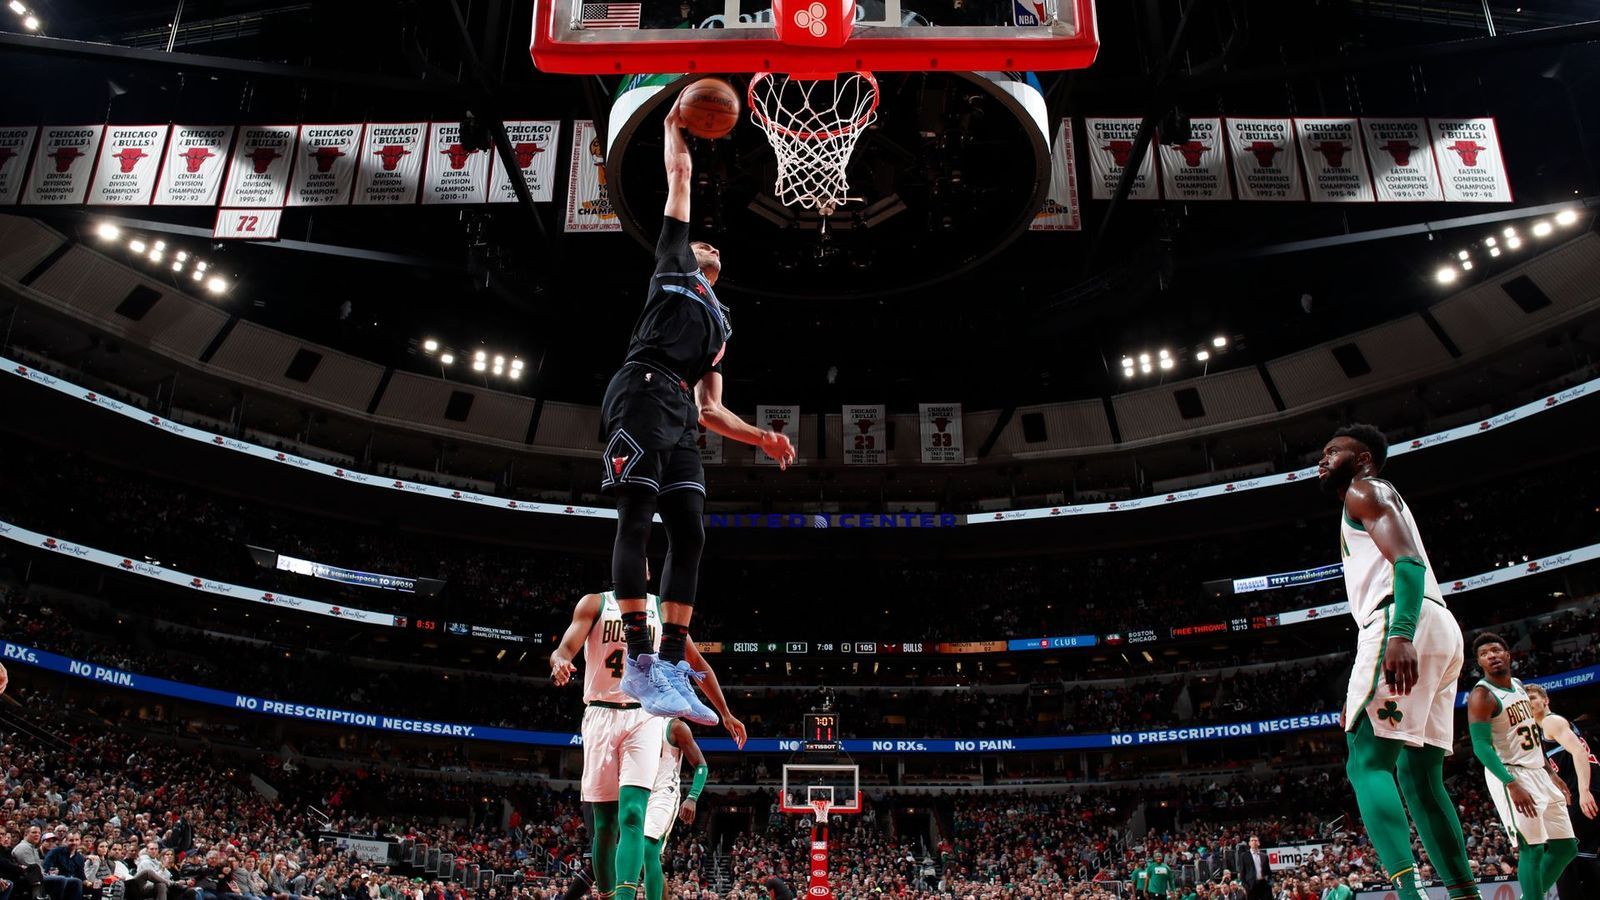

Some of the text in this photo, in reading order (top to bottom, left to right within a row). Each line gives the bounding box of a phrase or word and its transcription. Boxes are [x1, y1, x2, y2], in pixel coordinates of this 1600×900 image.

[1019, 15, 1035, 25] NBA
[113, 131, 158, 139] CHICAGO
[374, 128, 418, 136] CHICAGO
[314, 138, 346, 146] BULLS
[511, 134, 544, 142] BULLS
[237, 216, 258, 231] 72
[855, 435, 874, 449] 23
[932, 433, 952, 447] 33
[703, 512, 957, 529] NITED CENTER
[391, 580, 414, 588] 69050
[1271, 577, 1289, 585] TEXT
[417, 620, 435, 629] 8:53
[472, 631, 500, 639] CHARLOTTE
[1128, 630, 1154, 638] BOSTON
[1173, 628, 1191, 636] FREE
[1194, 623, 1226, 633] THROWS
[1054, 638, 1077, 646] CLUB
[1128, 635, 1158, 643] CHICAGO
[733, 643, 758, 652] CELTICS
[903, 643, 922, 652] BULLS
[4, 643, 134, 686] RXs. NO PAIN.
[1565, 672, 1595, 686] THERAPY
[236, 695, 475, 736] NO PRESCRIPTION NECESSARY.
[814, 717, 834, 726] 7:07
[816, 727, 832, 741] 11
[1111, 713, 1341, 745] NO PRESCRIPTION NECESSAR
[873, 741, 927, 751] NO RXs.
[955, 740, 1016, 751] NO PAIN.
